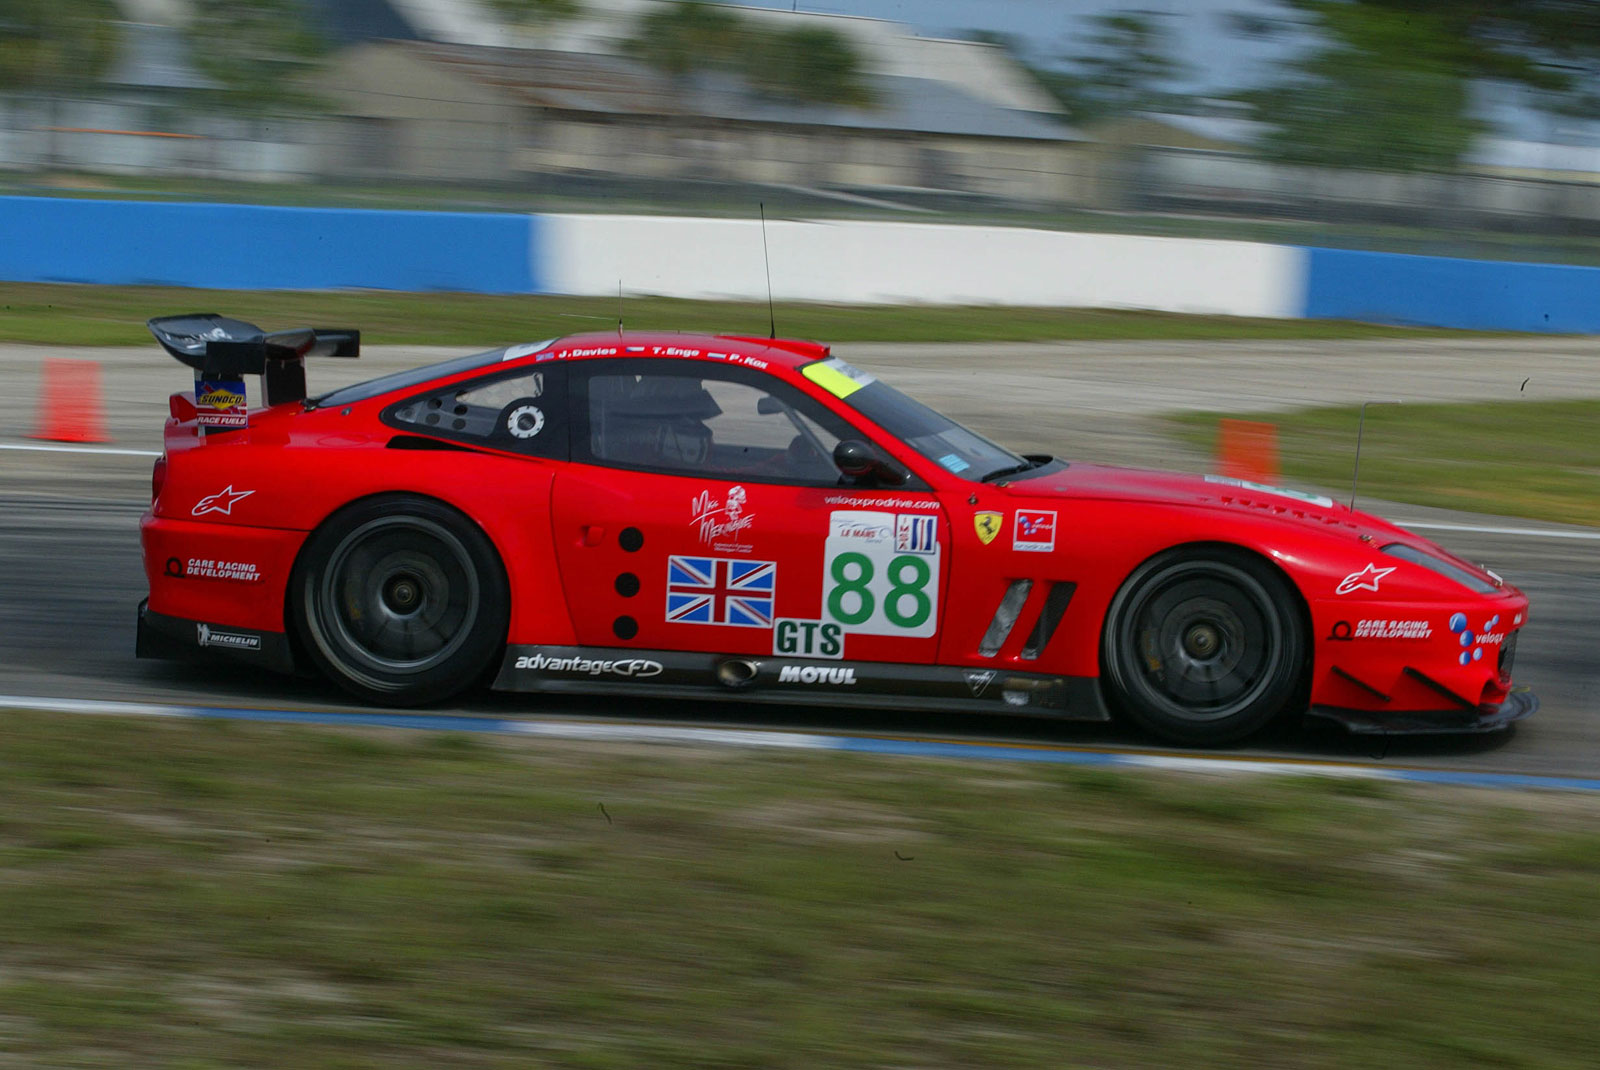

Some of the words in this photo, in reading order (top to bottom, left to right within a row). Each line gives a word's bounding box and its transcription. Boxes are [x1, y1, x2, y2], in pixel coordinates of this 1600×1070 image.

[202, 395, 242, 404] SUNOCO
[198, 416, 220, 424] RACE
[220, 417, 246, 425] FUELS
[823, 495, 941, 510] veloqxprodrive.com
[188, 559, 215, 568] CARE
[217, 561, 256, 571] RACING
[187, 567, 260, 580] DEVELOPMENT
[827, 551, 932, 629] 88
[1357, 619, 1388, 629] CARE
[1388, 620, 1430, 630] RACING
[776, 620, 842, 656] GTS
[1354, 628, 1434, 639] DEVELOPMENT
[210, 634, 258, 646] MICHELIN
[778, 665, 858, 685] MOTUL
